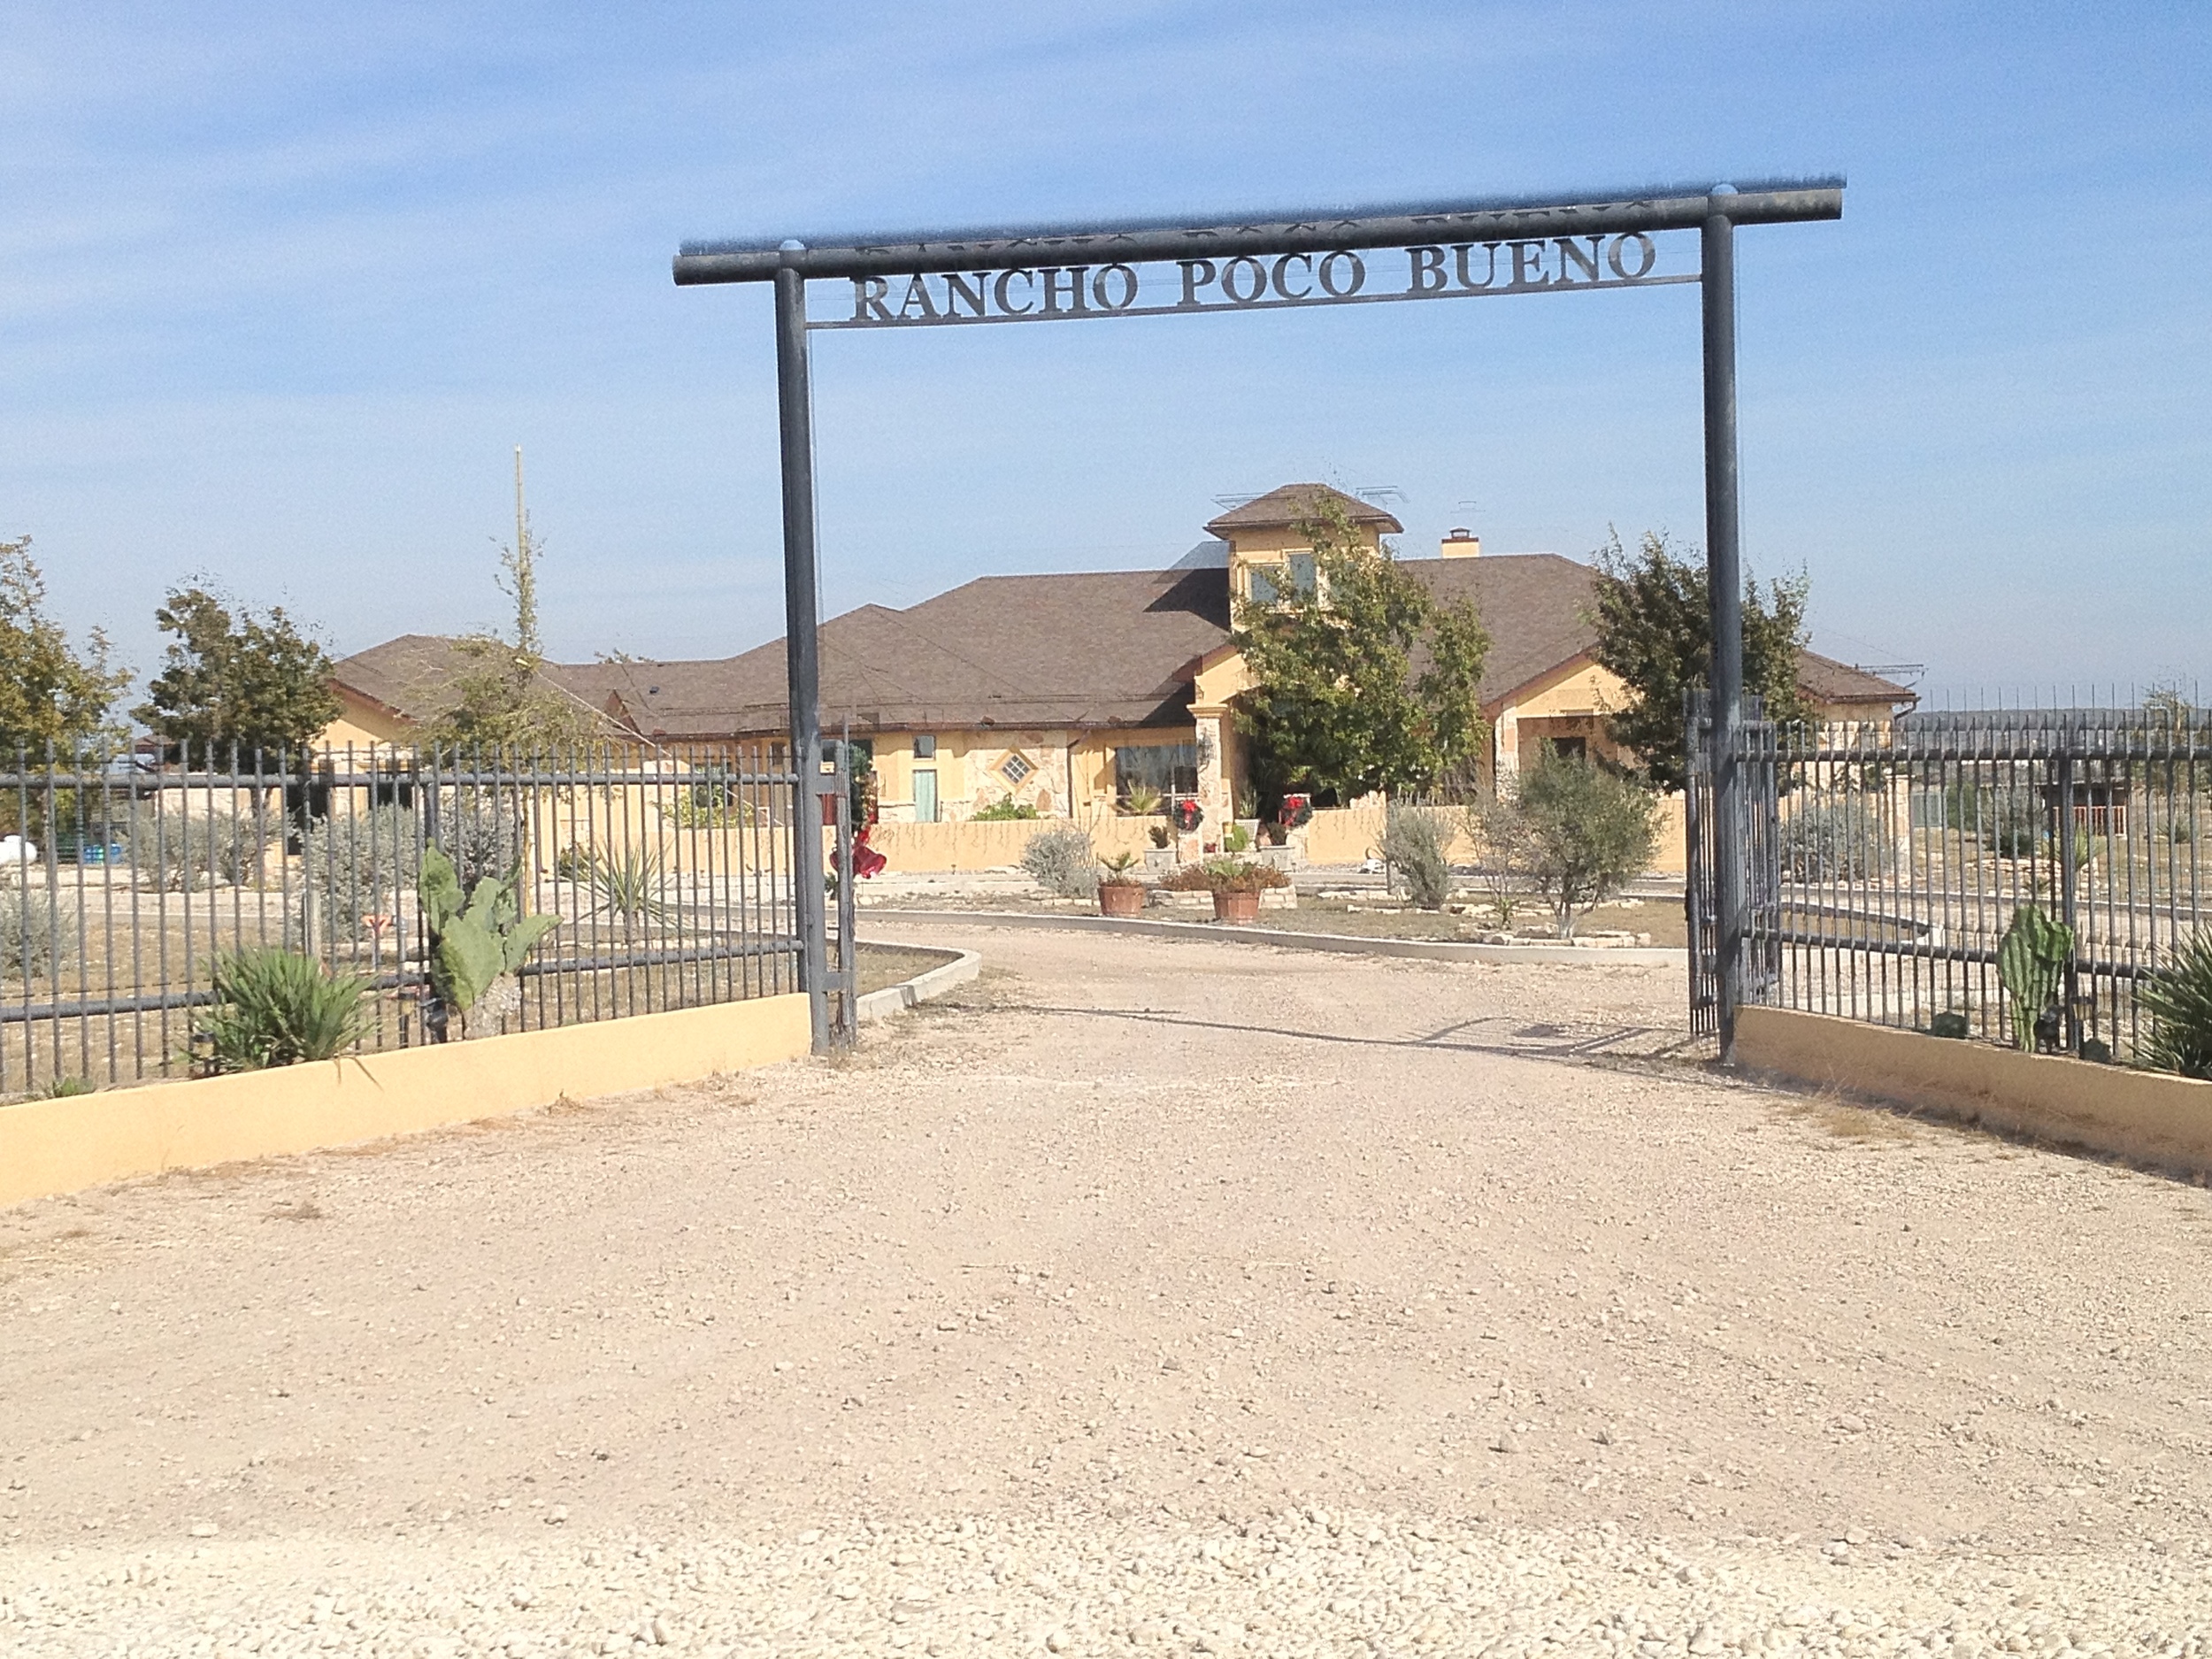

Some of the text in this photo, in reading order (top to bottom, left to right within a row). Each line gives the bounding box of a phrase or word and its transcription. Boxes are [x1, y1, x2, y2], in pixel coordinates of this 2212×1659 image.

[850, 233, 1655, 322] RANCHO POCO BUENO
